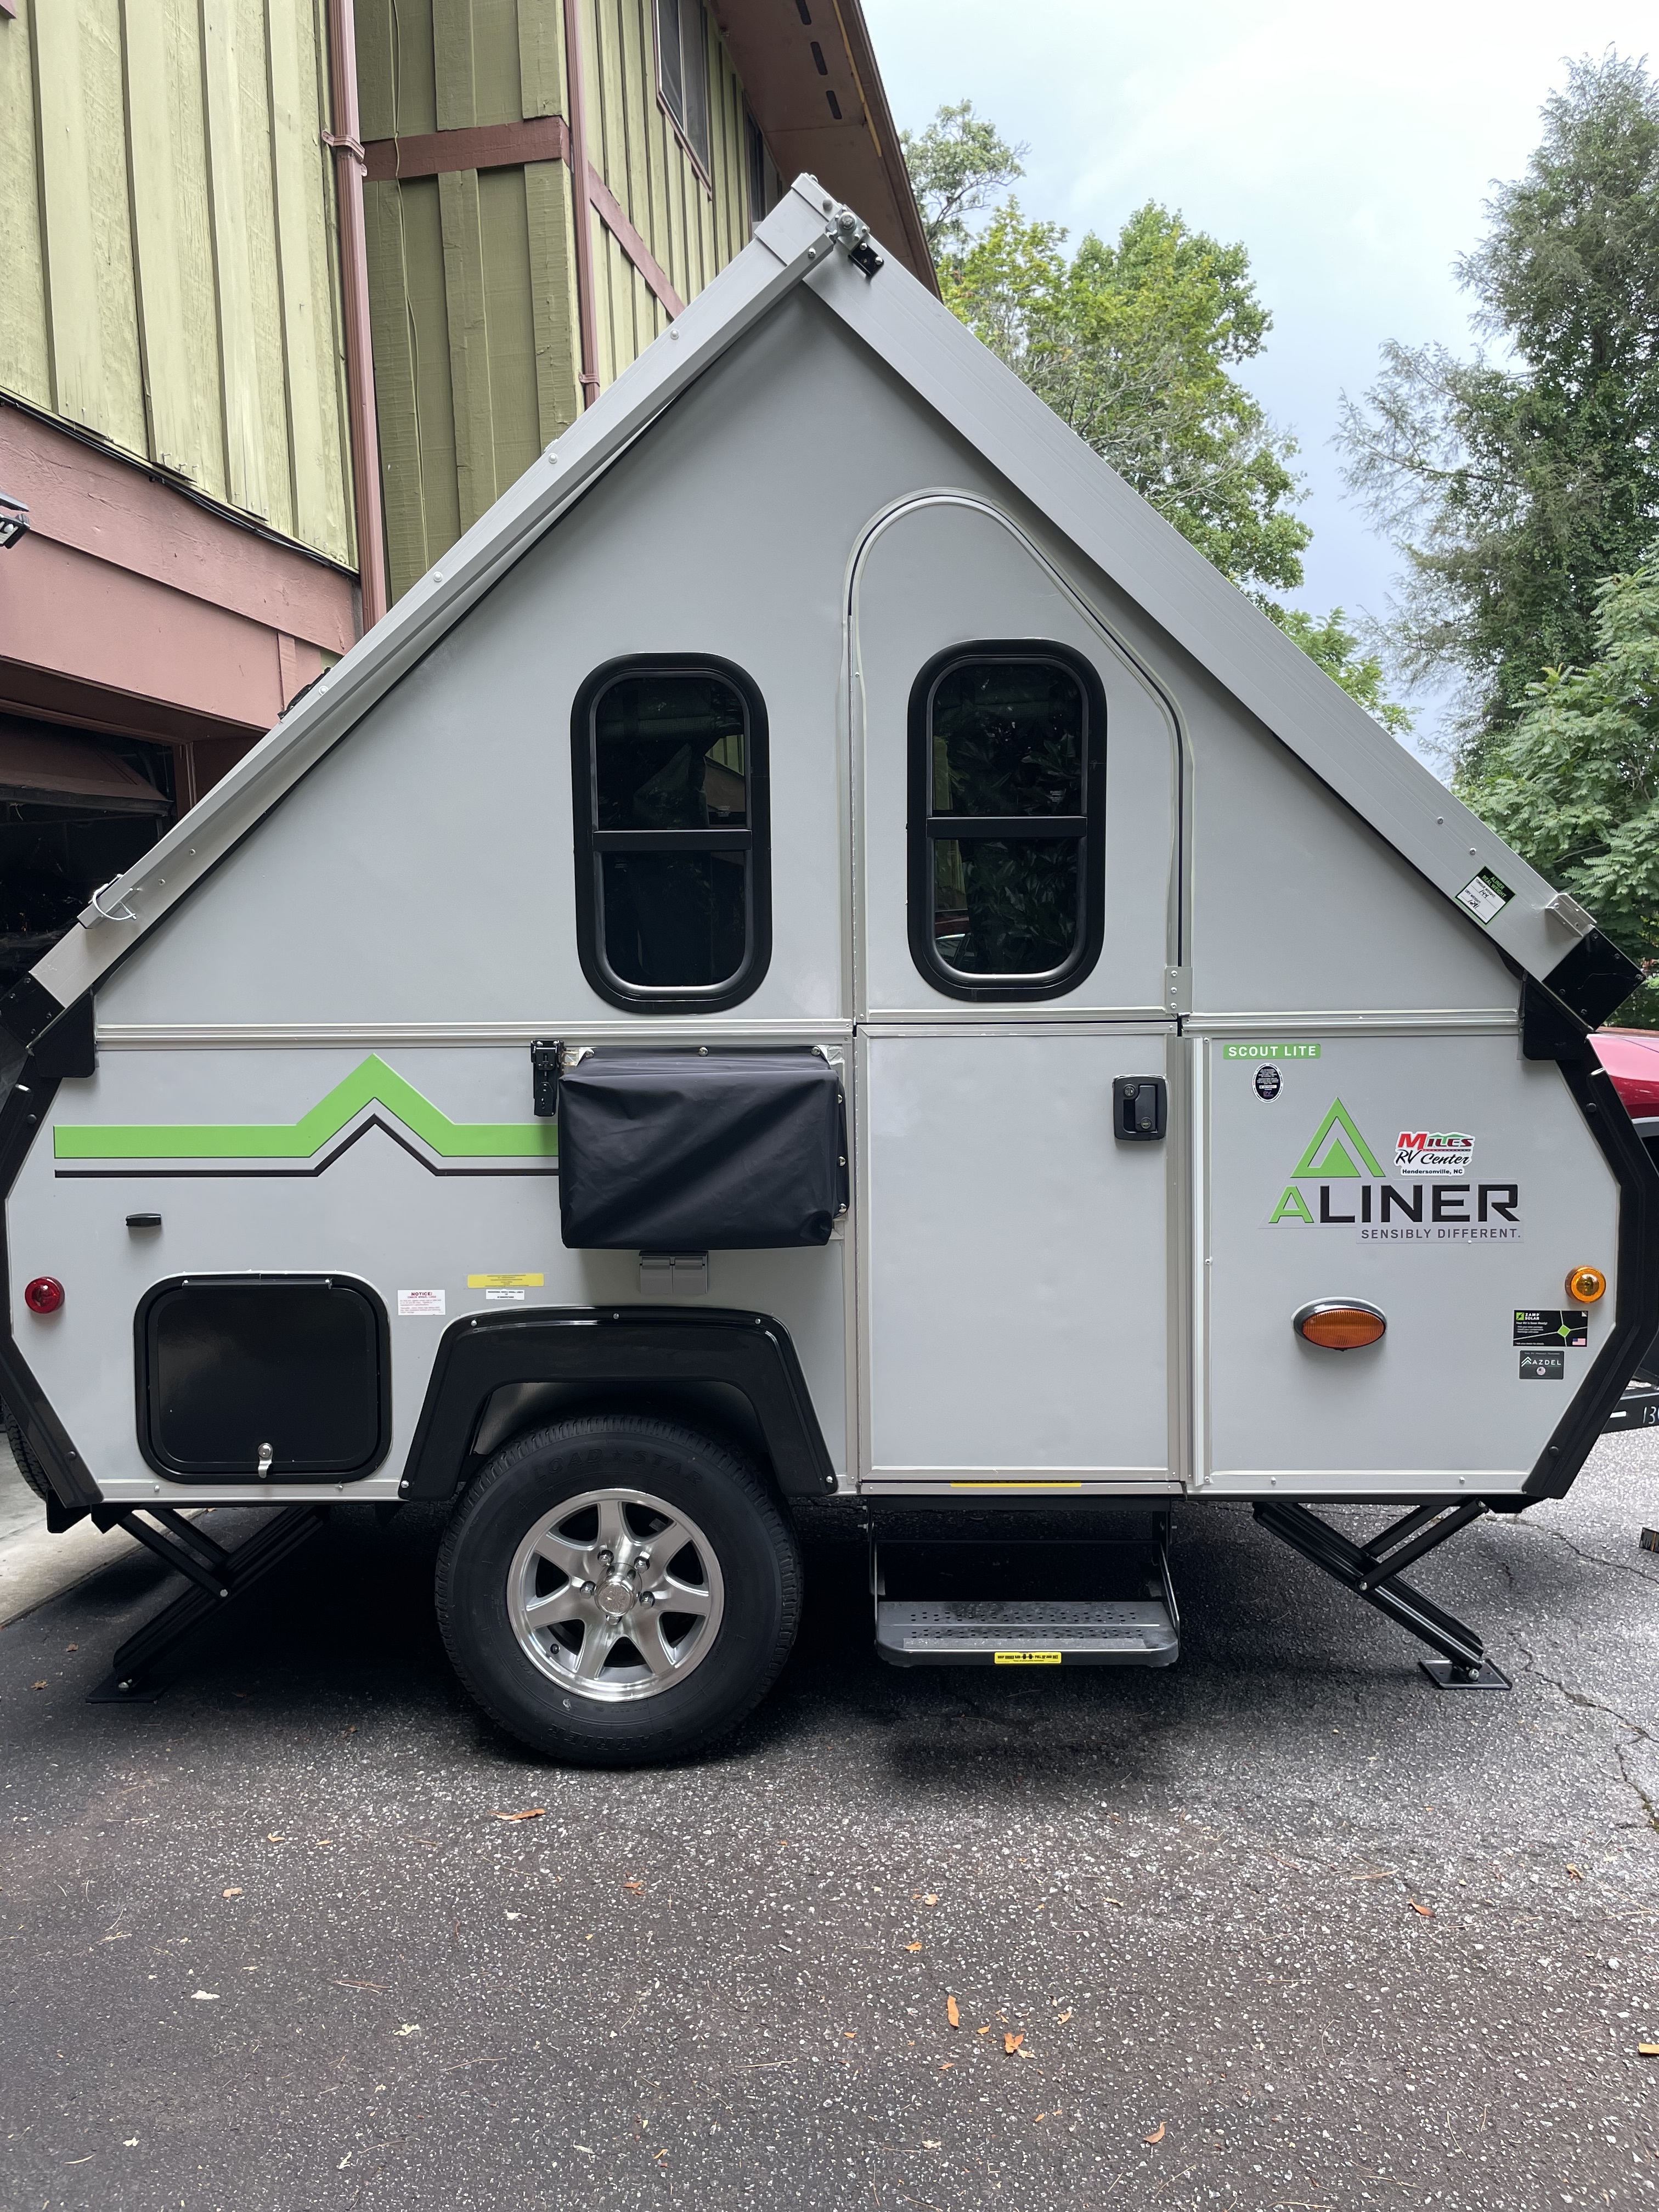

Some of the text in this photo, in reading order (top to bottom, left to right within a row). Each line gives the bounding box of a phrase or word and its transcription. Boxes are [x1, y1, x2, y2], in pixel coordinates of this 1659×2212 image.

[1482, 874, 1506, 898] REAL WEIGHT
[1491, 877, 1505, 890] ALINER
[1228, 1046, 1316, 1057] SCOUT LITE
[1396, 1149, 1470, 1164] RV Center
[1268, 1183, 1520, 1223] ALINER
[1361, 1228, 1521, 1239] SENSIBLY DIFFERENT.
[1643, 1406, 1659, 1424] 13
[534, 1448, 704, 1486] LOAD STAR
[546, 1723, 673, 1751] KARRIER
